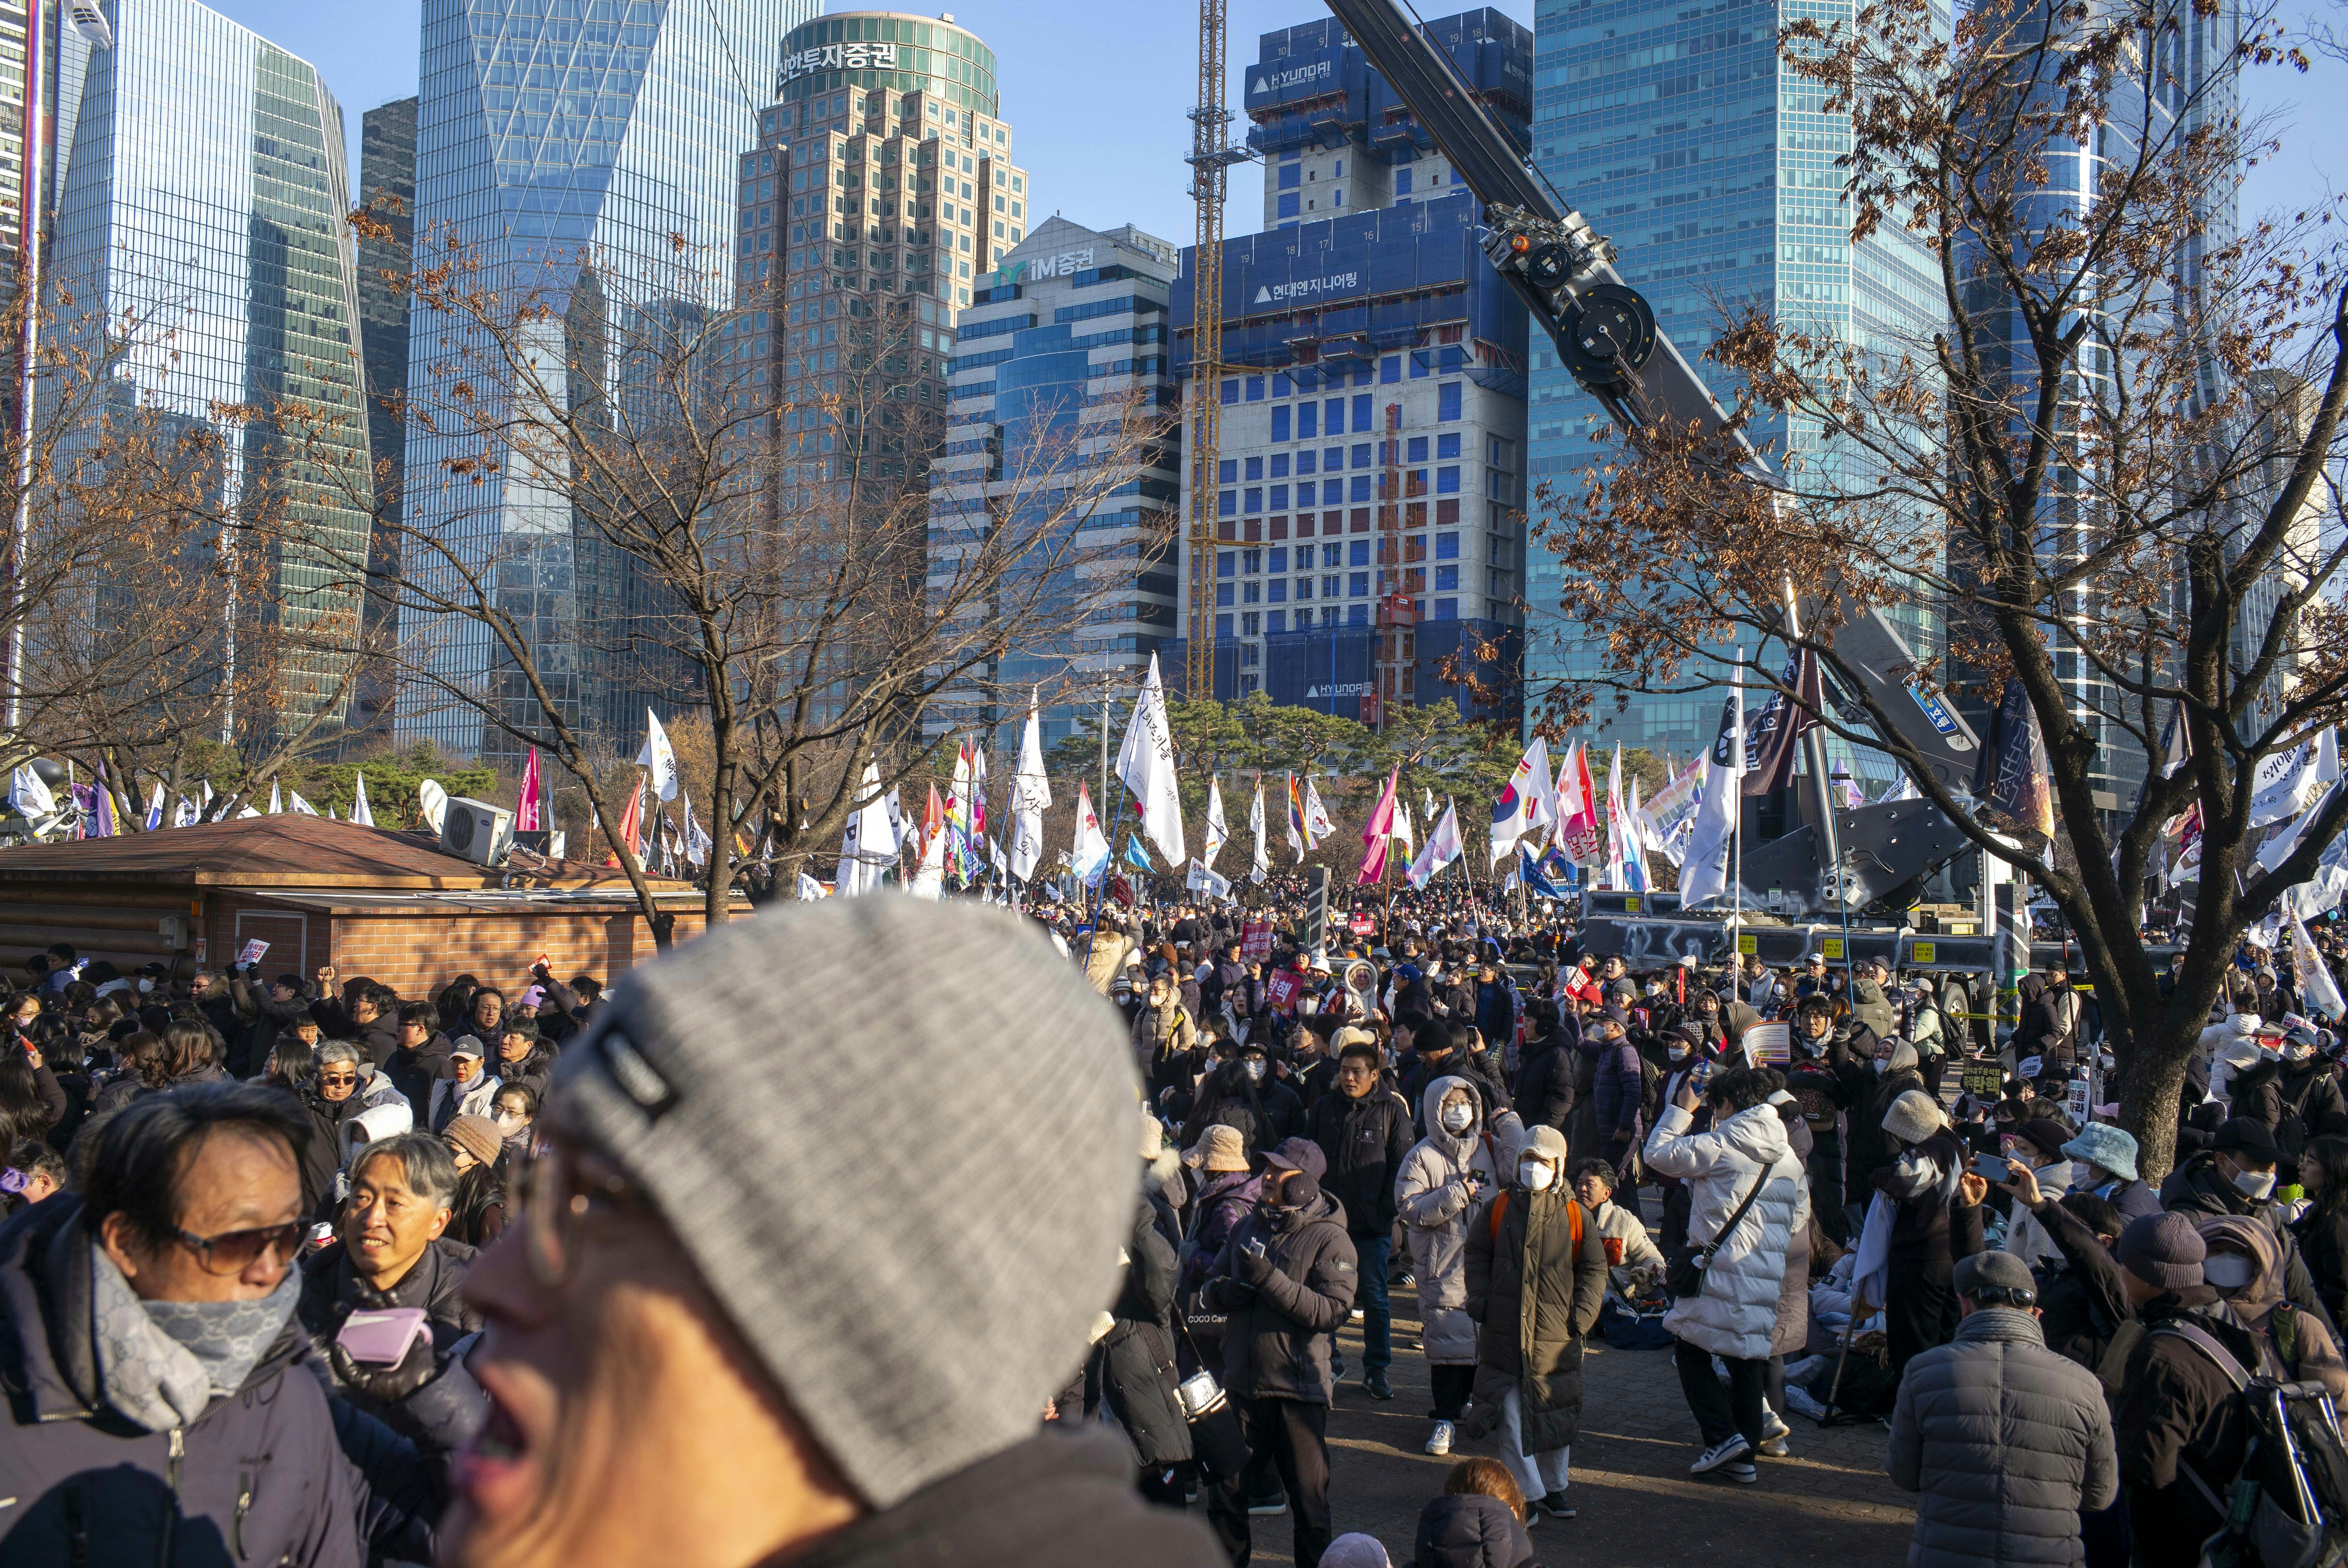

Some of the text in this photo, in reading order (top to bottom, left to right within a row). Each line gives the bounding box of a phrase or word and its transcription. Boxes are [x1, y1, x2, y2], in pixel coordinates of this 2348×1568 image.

[1343, 31, 1348, 40] 8
[1449, 33, 1459, 42] 19
[1472, 28, 1481, 38] 18
[1319, 37, 1324, 46] 9
[1278, 47, 1286, 56] 10
[778, 43, 896, 86] 신한투자증권
[1271, 60, 1330, 85] HYUNDAI
[1458, 213, 1469, 223] 14
[1411, 222, 1421, 232] 15
[1364, 231, 1374, 240] 16
[1319, 240, 1328, 249] 17
[1286, 246, 1295, 255] 18
[1240, 254, 1249, 263] 19
[1031, 247, 1093, 281] iM증권
[1273, 272, 1357, 301] 현대엔지니어링
[1320, 683, 1363, 693] HYUNDA
[1983, 1067, 2001, 1077] 윤석열
[1973, 1076, 2000, 1096] 탄핵
[1188, 1315, 1210, 1323] COCO
